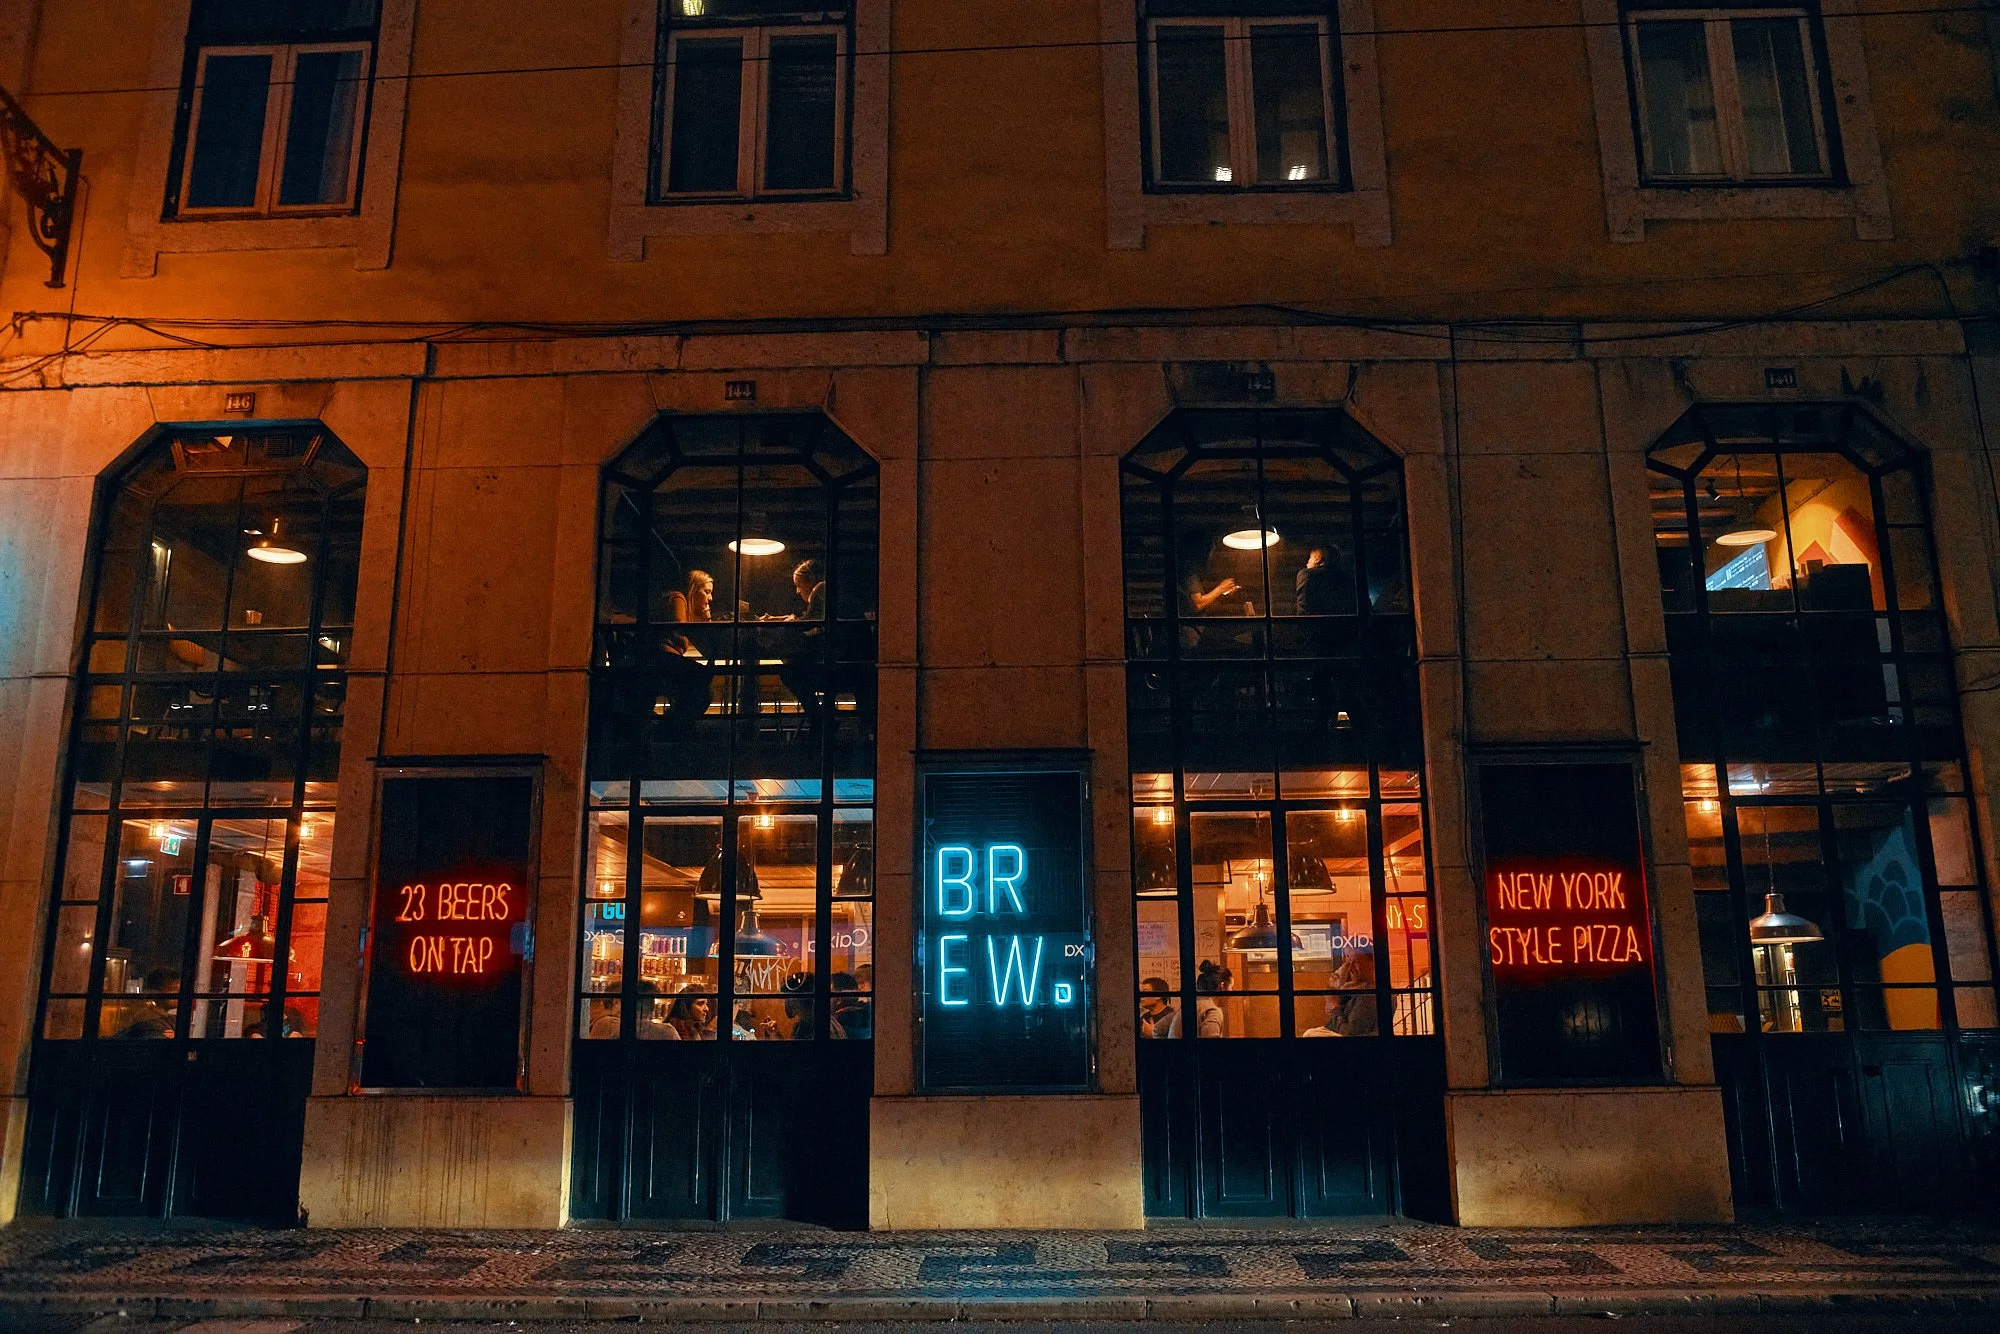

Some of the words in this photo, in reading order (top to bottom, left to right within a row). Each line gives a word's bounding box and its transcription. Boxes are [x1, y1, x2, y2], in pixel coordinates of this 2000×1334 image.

[227, 395, 251, 409] 146
[938, 845, 1023, 915] BR
[1498, 872, 1553, 910] NEW
[1560, 872, 1626, 910] YORK
[400, 883, 426, 921] 23
[437, 882, 511, 921] BEERS
[410, 935, 444, 973] ON
[449, 936, 493, 974] TAP
[1490, 926, 1563, 965] STYLE
[1573, 925, 1643, 963] PIZZA
